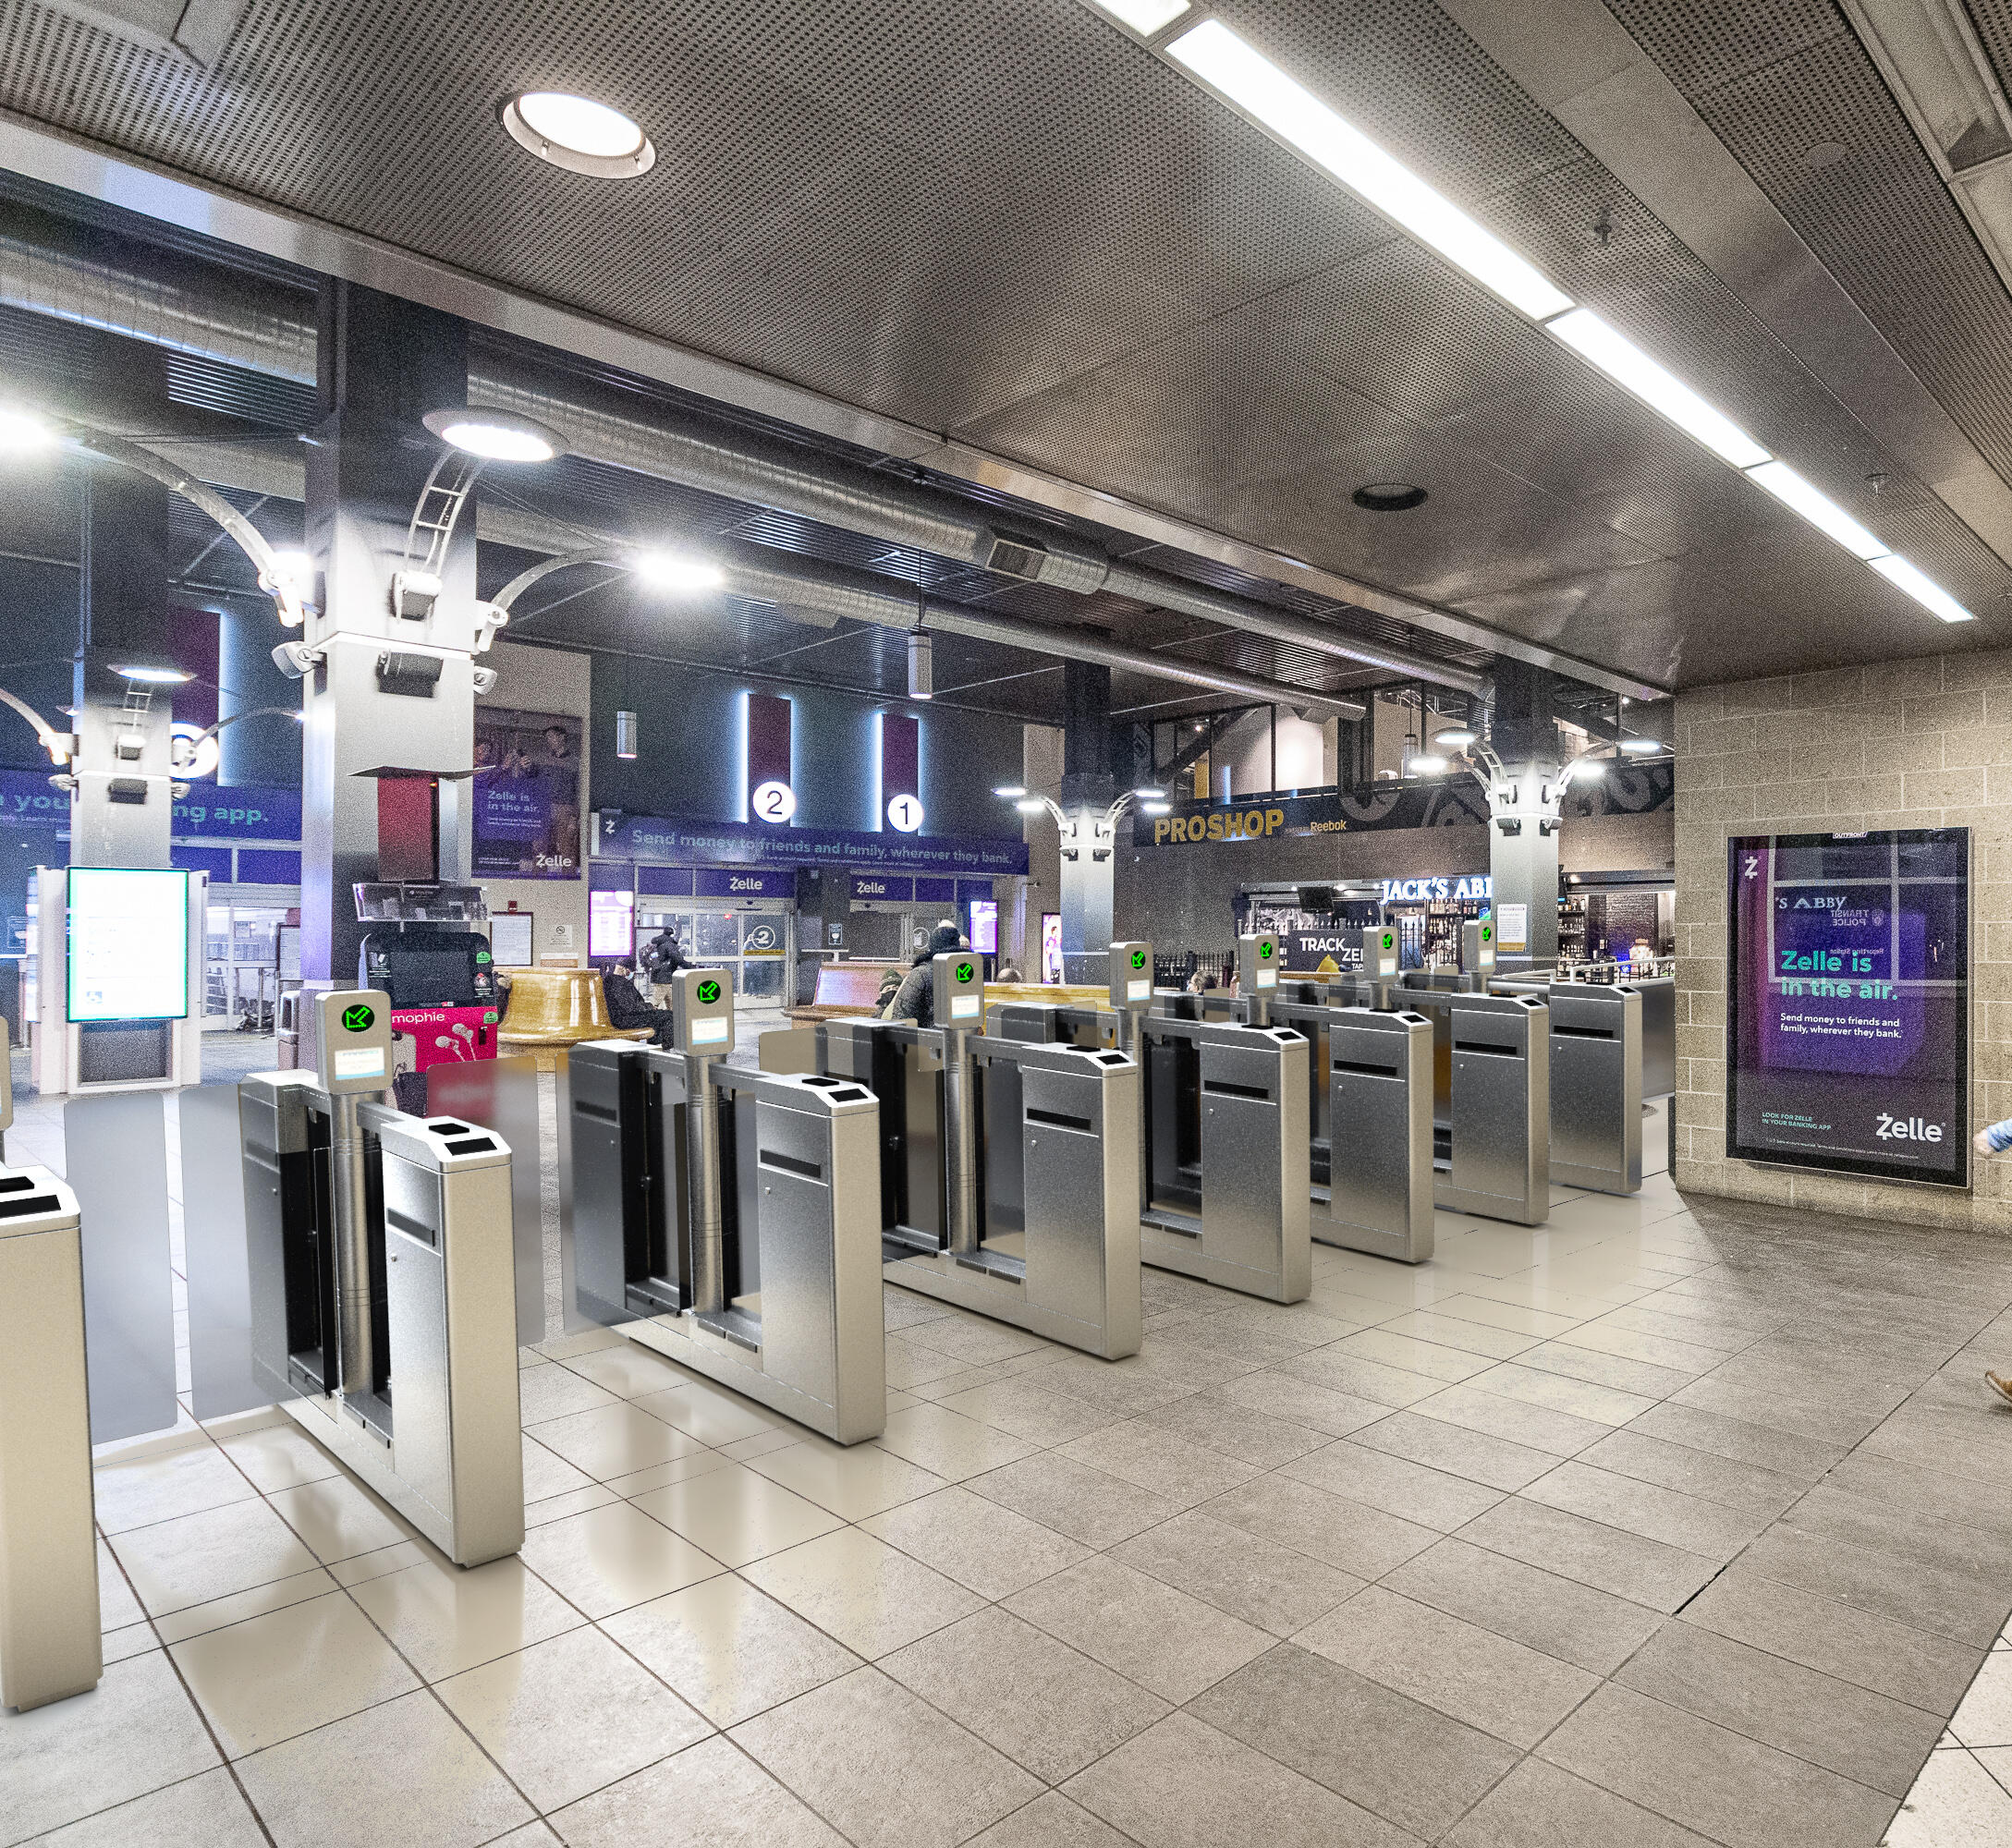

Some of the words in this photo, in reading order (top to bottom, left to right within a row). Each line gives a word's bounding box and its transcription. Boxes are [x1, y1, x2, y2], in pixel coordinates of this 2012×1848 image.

[14, 795, 70, 813] you
[488, 801, 499, 811] in
[502, 802, 520, 812] the
[766, 789, 784, 815] 2
[213, 807, 269, 826] app.
[898, 803, 909, 825] 1
[1155, 808, 1285, 845] PROSHOP
[1310, 819, 1347, 832] Reebok
[632, 829, 676, 845] Send
[680, 835, 738, 852] money
[740, 836, 755, 848] to
[760, 837, 811, 853] friends
[814, 842, 841, 855] and
[844, 844, 887, 859] family,
[890, 847, 951, 860] wherever
[953, 849, 980, 865] they
[982, 851, 1013, 864] bank.
[536, 853, 572, 869] Zelle
[729, 876, 763, 892] Zelle
[857, 881, 886, 894] Zelle
[1380, 876, 1449, 906] JACK'S
[1794, 896, 1847, 911] ABBY
[1299, 937, 1346, 952] TRACK
[1781, 950, 1842, 972] Zelle
[1852, 952, 1872, 972] is
[1781, 976, 1803, 997] in
[1810, 977, 1852, 999] the
[1859, 979, 1898, 1001] air.
[392, 1012, 445, 1025] mophie
[1780, 1013, 1803, 1022] Send
[1804, 1015, 1835, 1026] money
[1836, 1015, 1847, 1025] to
[1848, 1015, 1880, 1027] friends
[1882, 1018, 1900, 1027] and
[1780, 1023, 1809, 1035] family,
[1810, 1025, 1852, 1036] wherever
[1854, 1027, 1874, 1039] they
[1787, 1121, 1818, 1129] BANKING
[1875, 1112, 1943, 1143] Zelle
